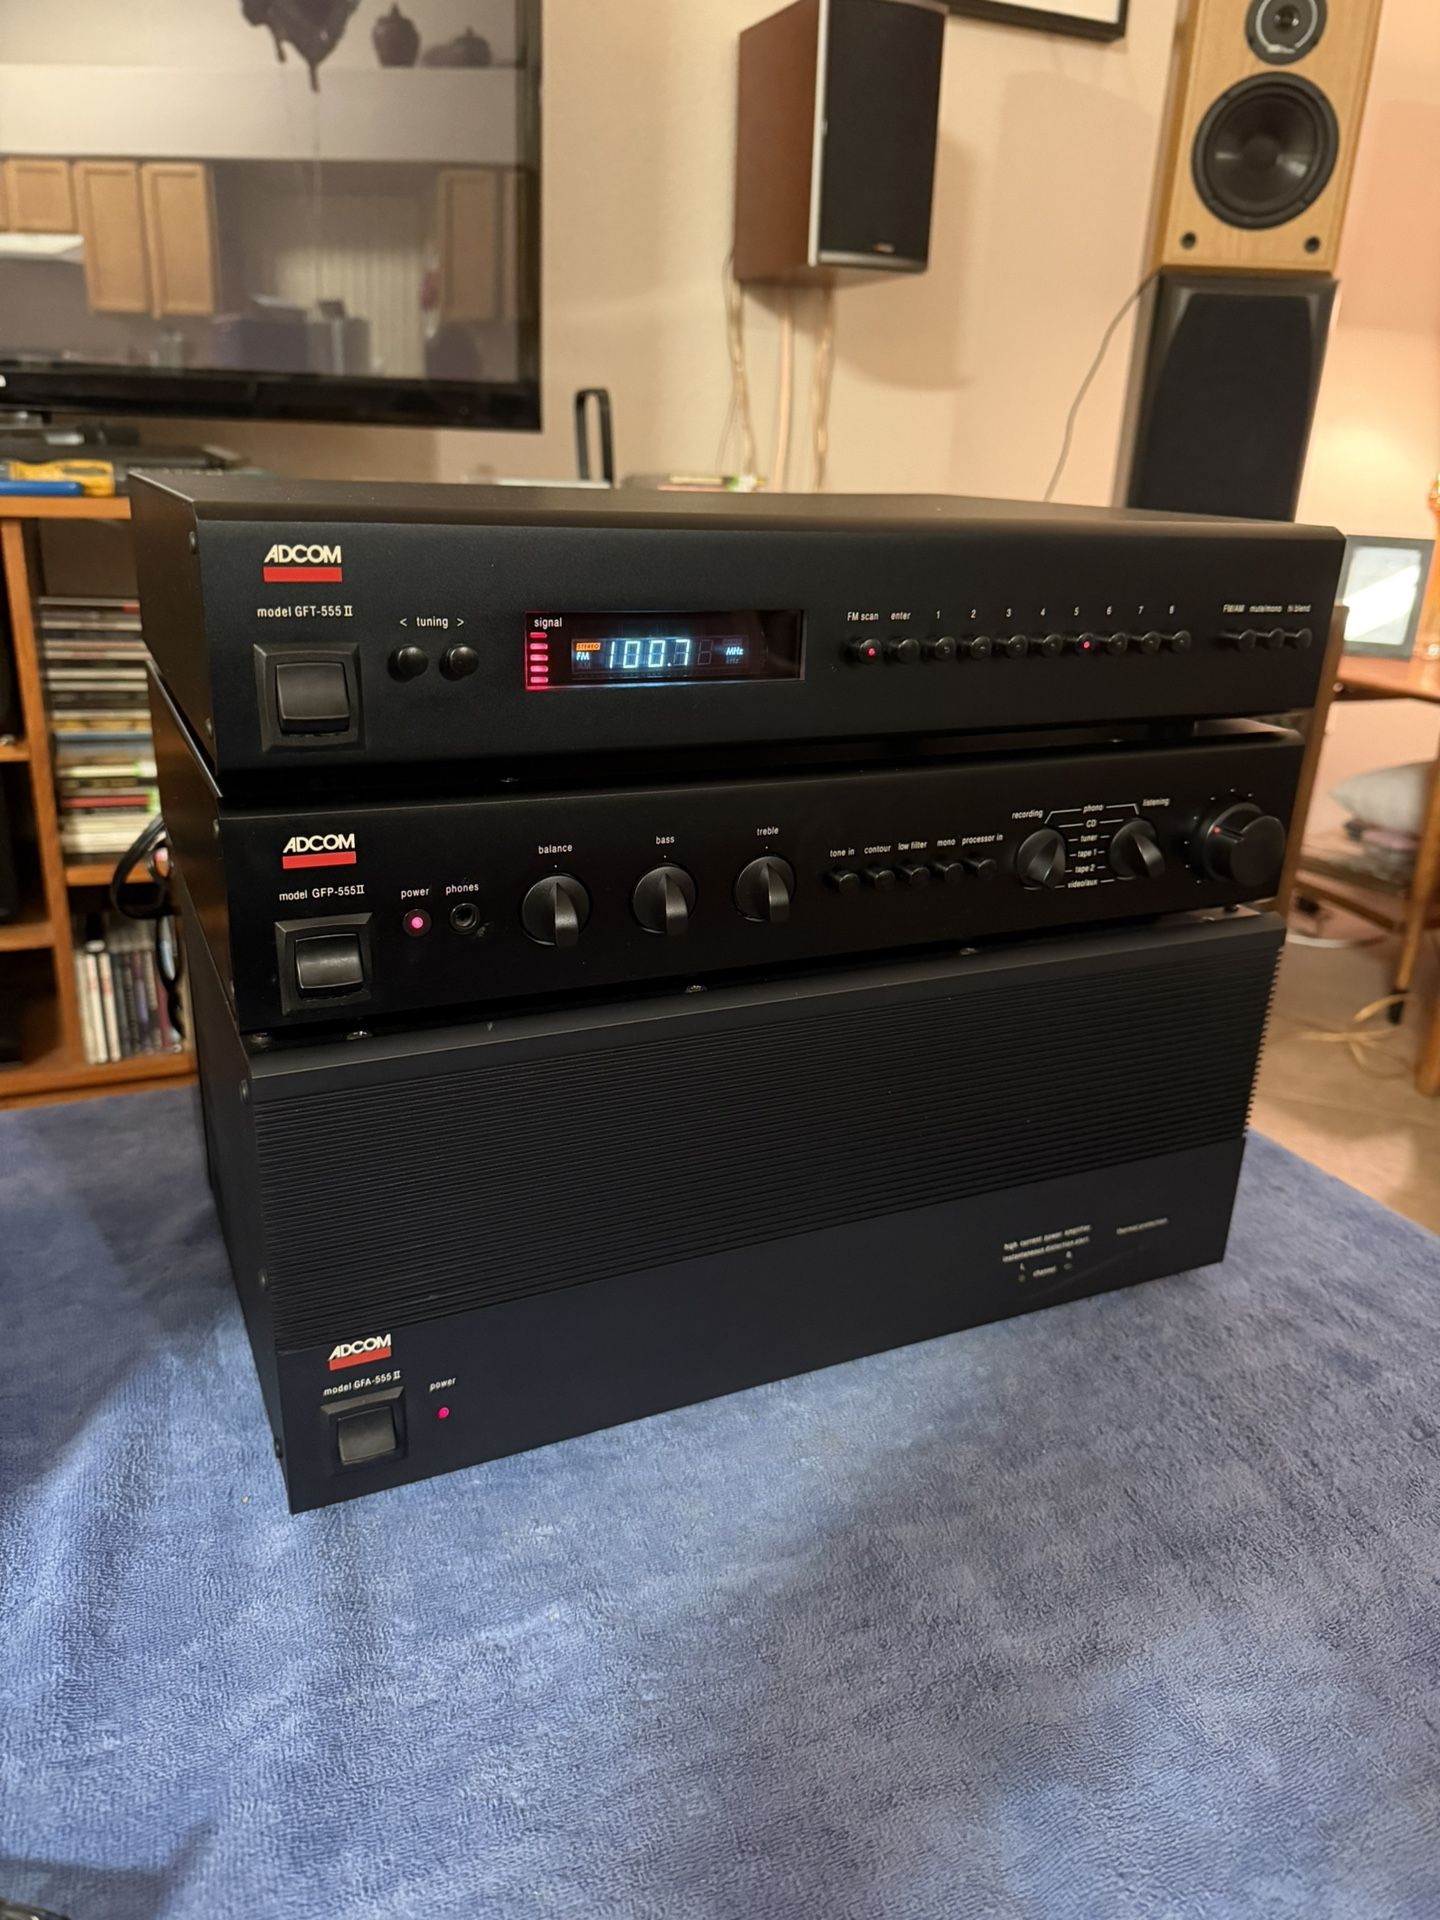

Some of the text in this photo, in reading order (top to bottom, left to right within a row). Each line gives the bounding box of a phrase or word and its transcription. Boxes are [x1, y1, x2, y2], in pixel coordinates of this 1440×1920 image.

[264, 544, 342, 564] ADCOM
[257, 606, 292, 617] model
[936, 610, 941, 619] 1
[970, 609, 977, 618] 2
[1006, 608, 1012, 618] 3
[1040, 608, 1046, 617] 4
[1074, 607, 1080, 616] 5
[1106, 605, 1112, 615] 6
[1138, 605, 1144, 615] 7
[847, 611, 879, 622] FM scan
[890, 611, 911, 621] enter
[416, 616, 449, 629] tuning
[534, 617, 563, 629] signal
[609, 639, 691, 669] 100.7
[726, 646, 744, 656] MHz
[576, 652, 590, 661] FM
[1082, 804, 1104, 813] phono
[1012, 809, 1044, 820] recording
[1086, 819, 1098, 828] CD
[756, 826, 780, 836] treble
[283, 833, 355, 853] ADCOM
[655, 835, 675, 845] bass
[937, 838, 956, 847] mono
[961, 833, 1003, 846] processor in
[1080, 834, 1098, 842] tuner
[538, 843, 573, 855] balance
[864, 844, 892, 855] contour
[898, 841, 928, 851] low filter
[829, 848, 855, 858] tone in
[1077, 850, 1092, 859] tape
[1075, 865, 1090, 874] tape
[400, 887, 430, 900] power
[445, 883, 480, 896] phones
[279, 889, 308, 902] model
[328, 1333, 392, 1361] ADCOM
[323, 1382, 352, 1396] model
[428, 1377, 456, 1392] power
